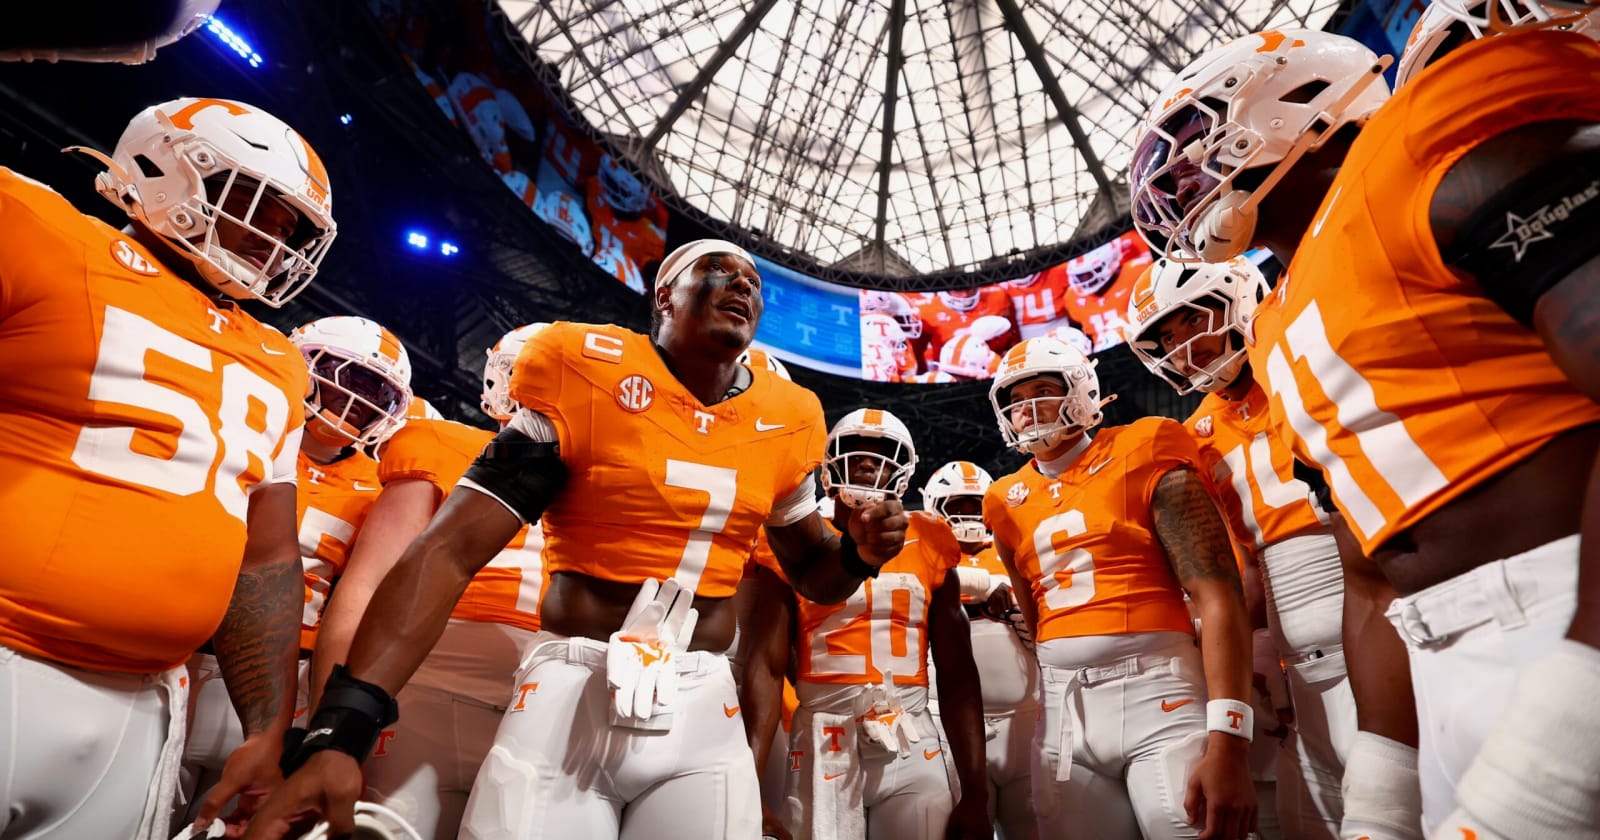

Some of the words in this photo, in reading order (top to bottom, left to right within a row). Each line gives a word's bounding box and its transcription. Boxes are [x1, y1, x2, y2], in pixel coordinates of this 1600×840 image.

[764, 282, 784, 306] T
[208, 307, 229, 334] T
[831, 304, 853, 326] T
[796, 322, 817, 346] T
[873, 321, 890, 337] T
[584, 332, 624, 357] C
[618, 375, 654, 410] SEC
[71, 304, 289, 523] 58
[693, 409, 716, 434] T
[1236, 402, 1250, 422] T
[1267, 299, 1450, 541] 11
[307, 466, 325, 485] T
[1049, 481, 1062, 499] T
[664, 459, 737, 592] 7
[1033, 509, 1096, 611] 6
[809, 572, 926, 676] 20
[511, 682, 539, 713] T
[1227, 710, 1244, 730] T
[823, 726, 846, 752] T
[790, 750, 806, 771] T
